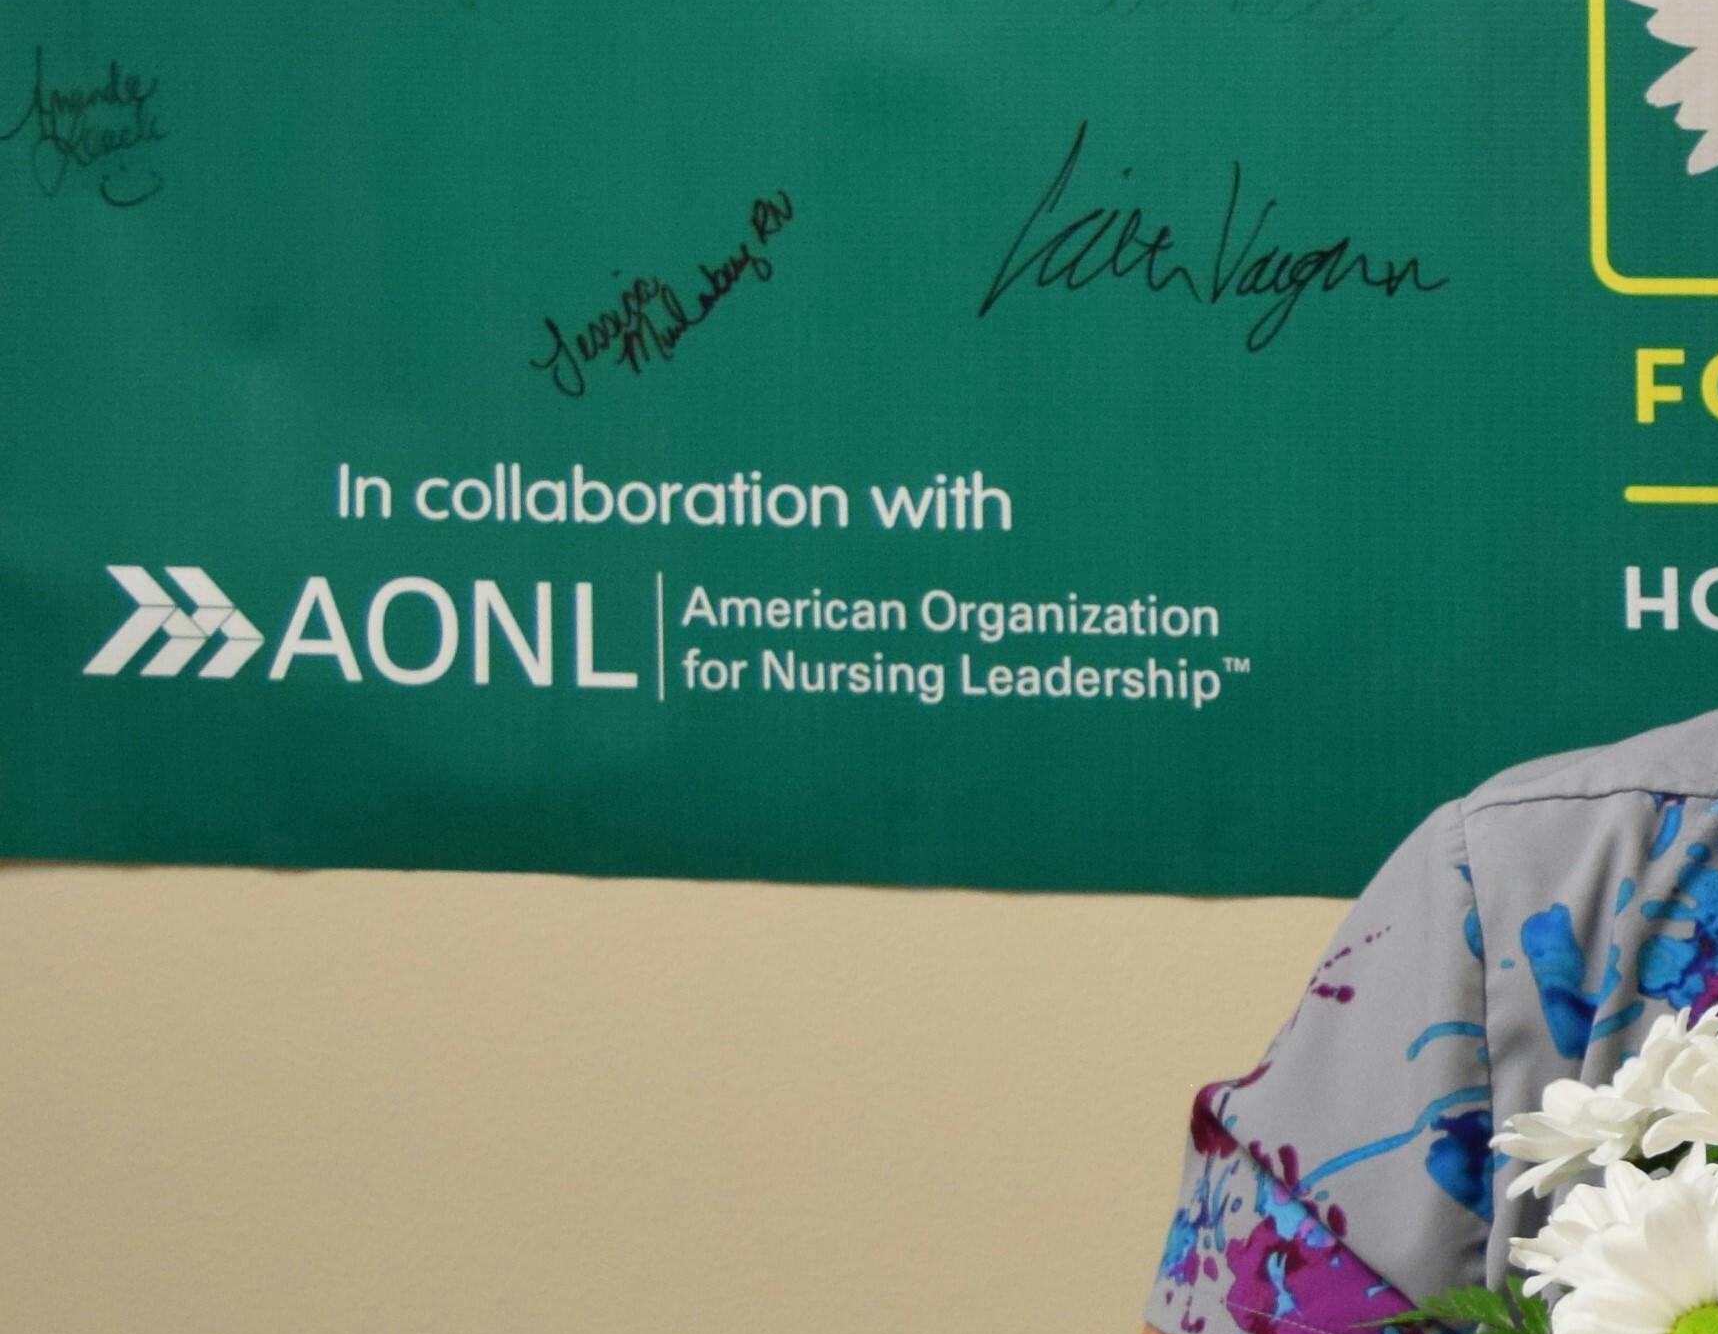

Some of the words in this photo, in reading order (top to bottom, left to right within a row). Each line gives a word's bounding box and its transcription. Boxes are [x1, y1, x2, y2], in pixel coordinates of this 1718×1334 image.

[338, 462, 391, 519] In
[415, 462, 849, 528] collaboration
[870, 470, 1012, 531] with
[268, 575, 638, 689] AONL
[681, 585, 907, 631] American
[920, 589, 1219, 643] Organization
[682, 647, 748, 690] for
[762, 649, 945, 704] Nursing
